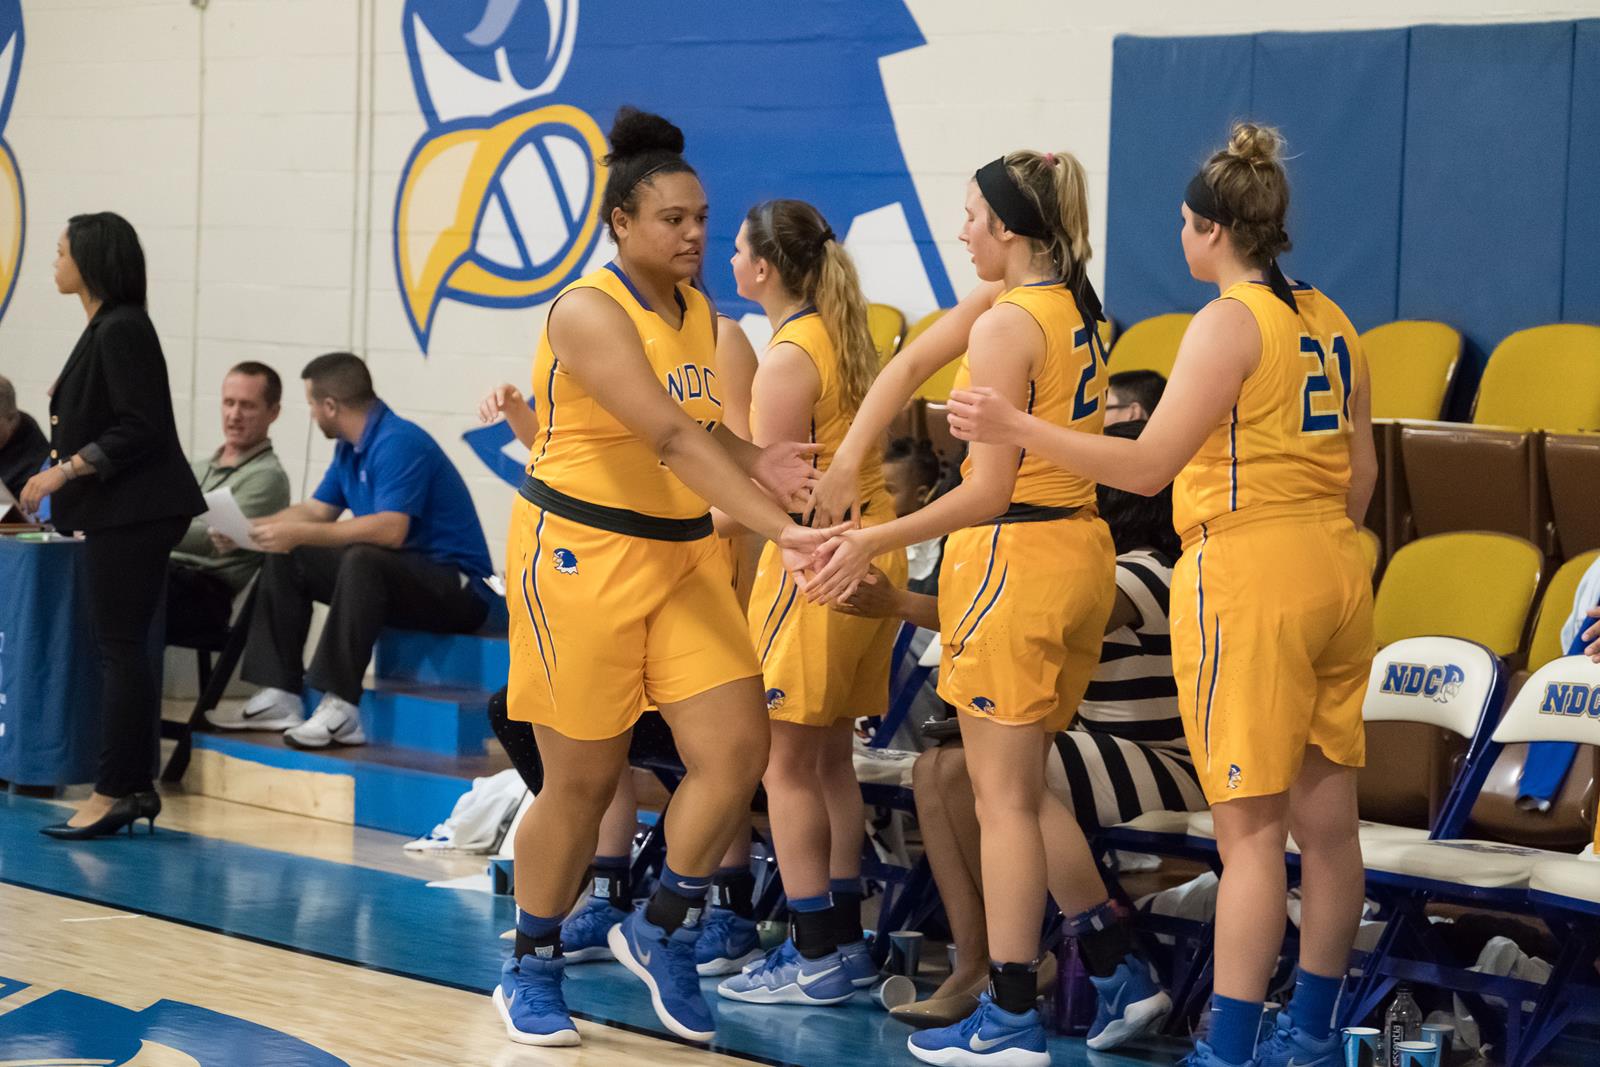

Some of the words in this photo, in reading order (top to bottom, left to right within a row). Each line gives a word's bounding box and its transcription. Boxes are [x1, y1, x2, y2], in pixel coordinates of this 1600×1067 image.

[666, 363, 722, 407] NDC
[1070, 325, 1108, 424] 2
[1299, 333, 1353, 436] 21
[1380, 661, 1443, 698] NDC
